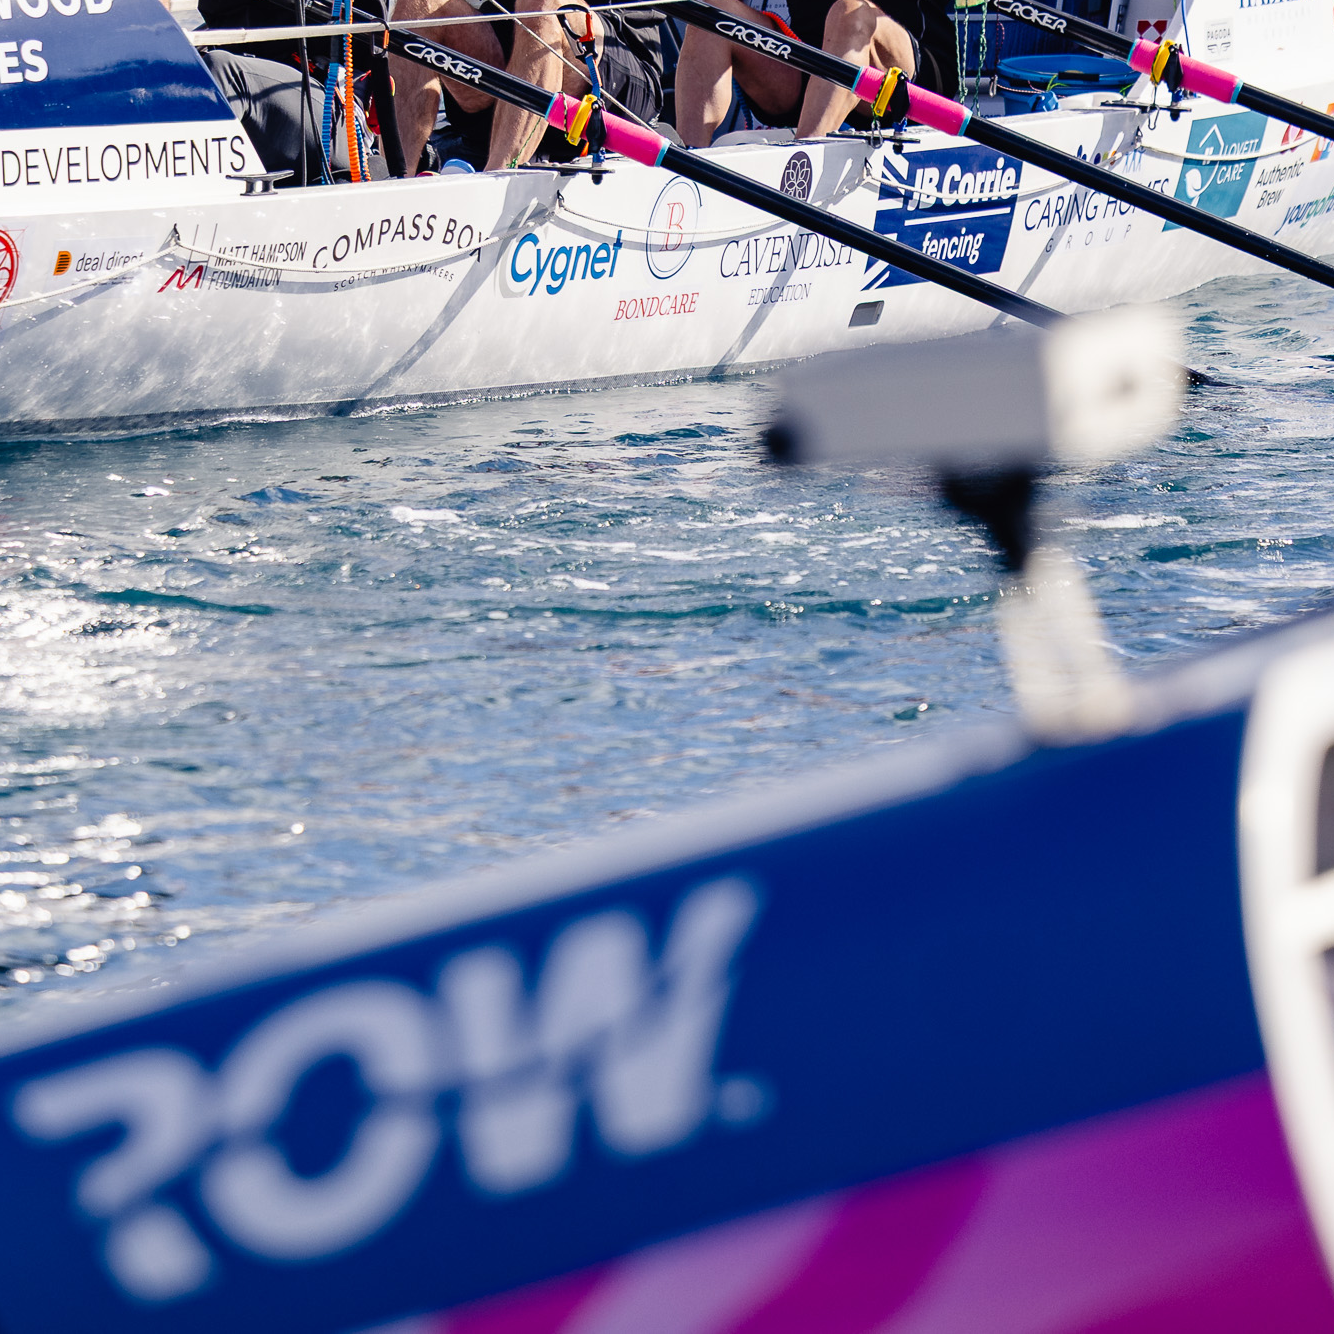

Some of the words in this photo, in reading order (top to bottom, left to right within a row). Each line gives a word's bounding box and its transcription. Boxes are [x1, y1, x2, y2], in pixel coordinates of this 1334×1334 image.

[994, 0, 1067, 33] CROKER
[1206, 28, 1231, 40] PAGODA
[715, 21, 792, 59] CROKER
[404, 43, 483, 84] CROKER
[1, 135, 245, 188] DEVELOPMENTS
[1217, 163, 1246, 184] CARE
[1255, 158, 1305, 188] Authentic
[907, 167, 940, 211] JB
[942, 157, 1017, 207] Corrie
[1256, 188, 1285, 209] Brew
[1024, 190, 1101, 232] CARING
[312, 213, 437, 268] COMPASS
[719, 232, 855, 278] CAVENDISH
[922, 227, 985, 265] fencing
[75, 252, 105, 272] deal
[208, 268, 283, 290] FOUNDATION
[511, 229, 622, 296] Cygnet
[613, 292, 700, 321] BONDCARE
[747, 283, 813, 306] EDUCATION
